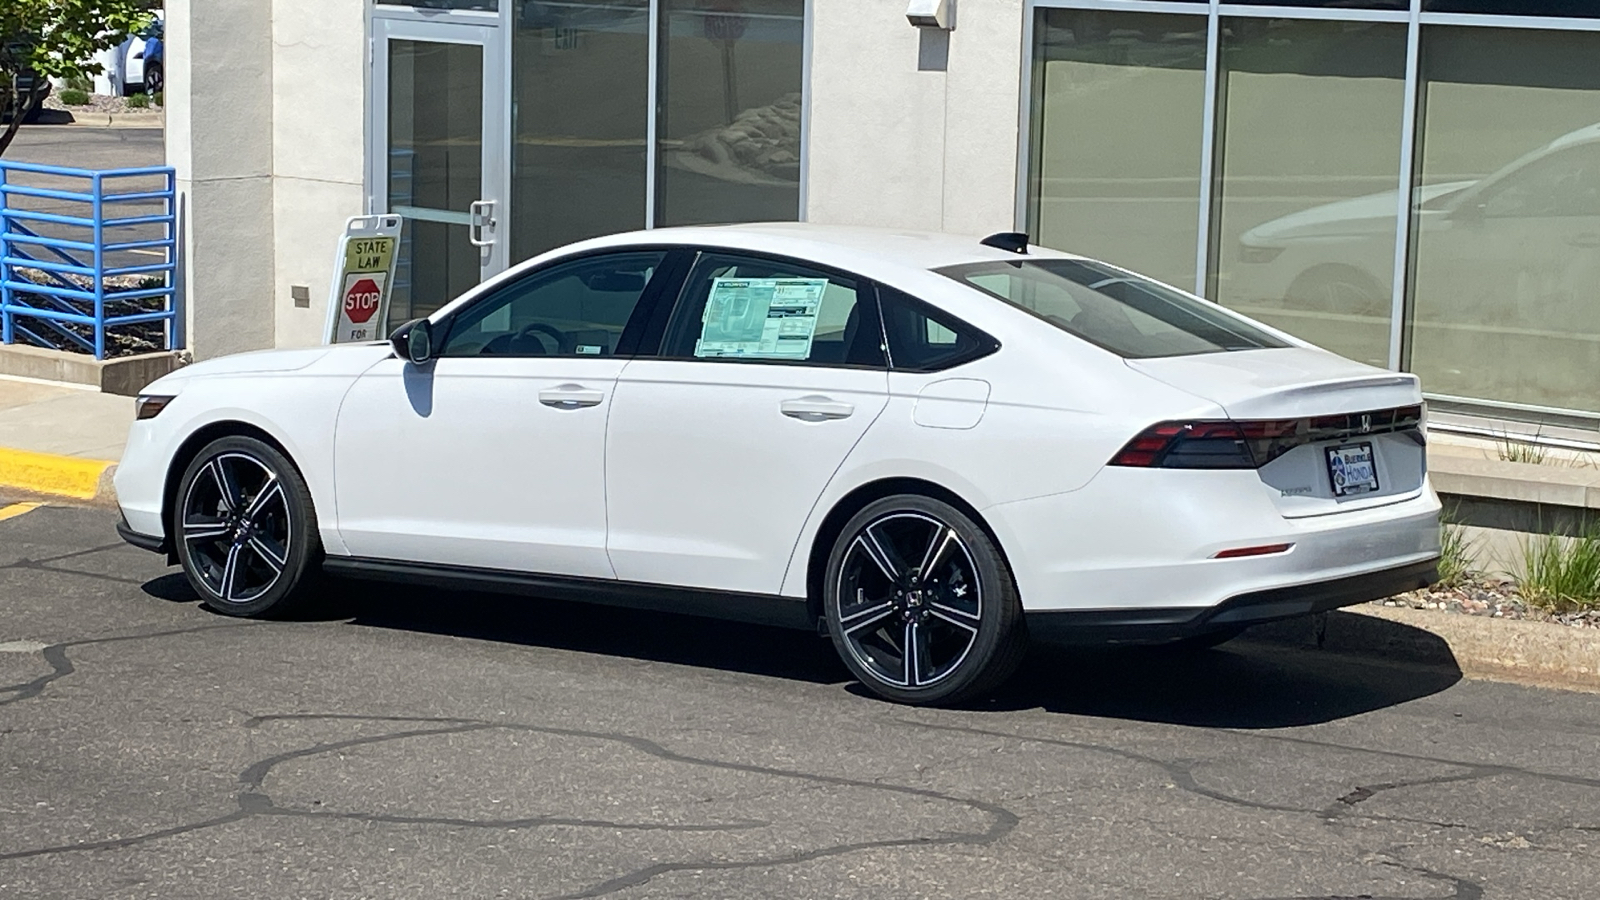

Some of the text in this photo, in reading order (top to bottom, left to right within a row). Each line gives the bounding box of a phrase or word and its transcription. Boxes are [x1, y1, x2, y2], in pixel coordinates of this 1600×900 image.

[355, 241, 387, 255] STATE
[358, 256, 381, 269] LAW
[345, 292, 379, 311] STOP
[350, 329, 367, 340] FOR
[1346, 465, 1374, 482] HONDA
